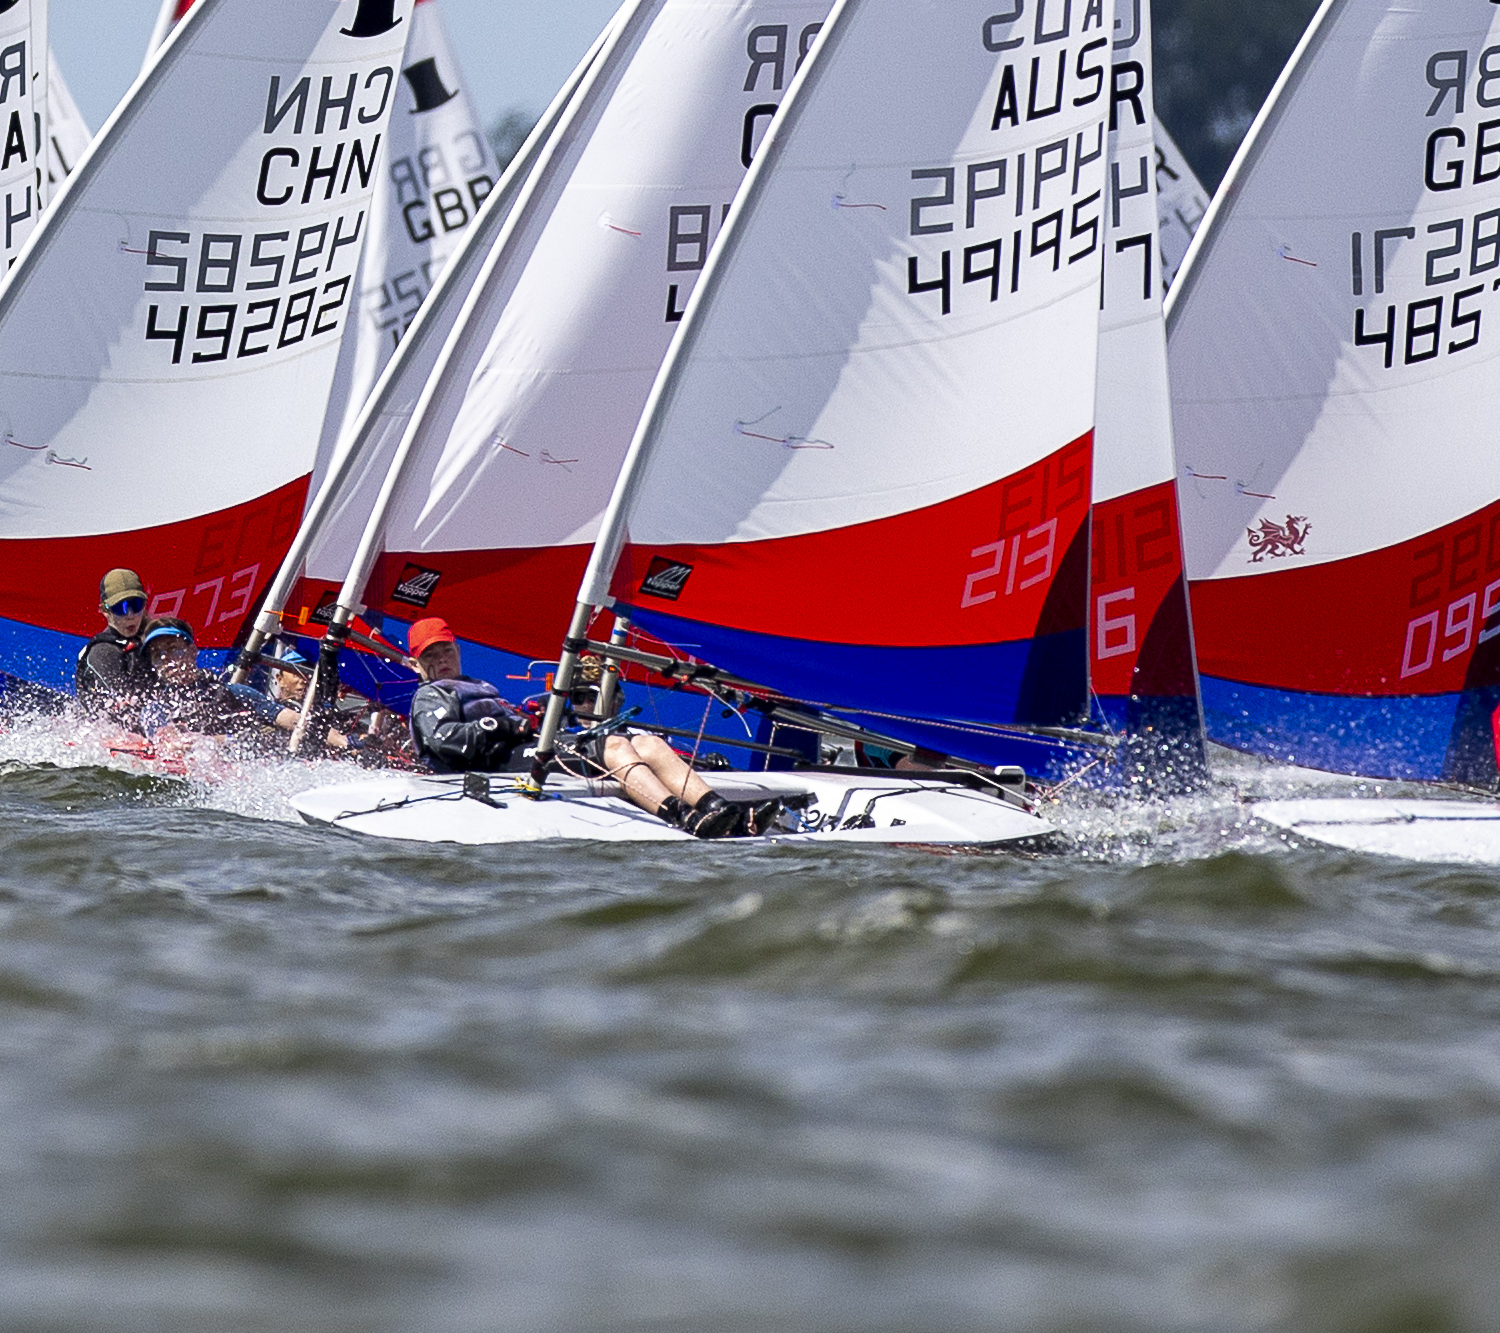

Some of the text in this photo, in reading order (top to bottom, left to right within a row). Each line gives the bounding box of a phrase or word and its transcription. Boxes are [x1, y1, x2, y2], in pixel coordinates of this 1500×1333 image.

[990, 36, 1108, 131] AUS
[256, 133, 382, 206] CHN
[907, 189, 1101, 315] 49195
[145, 274, 351, 365] 49282
[397, 582, 429, 599] topper
[647, 576, 680, 592] topper
[960, 517, 1058, 609] 213
